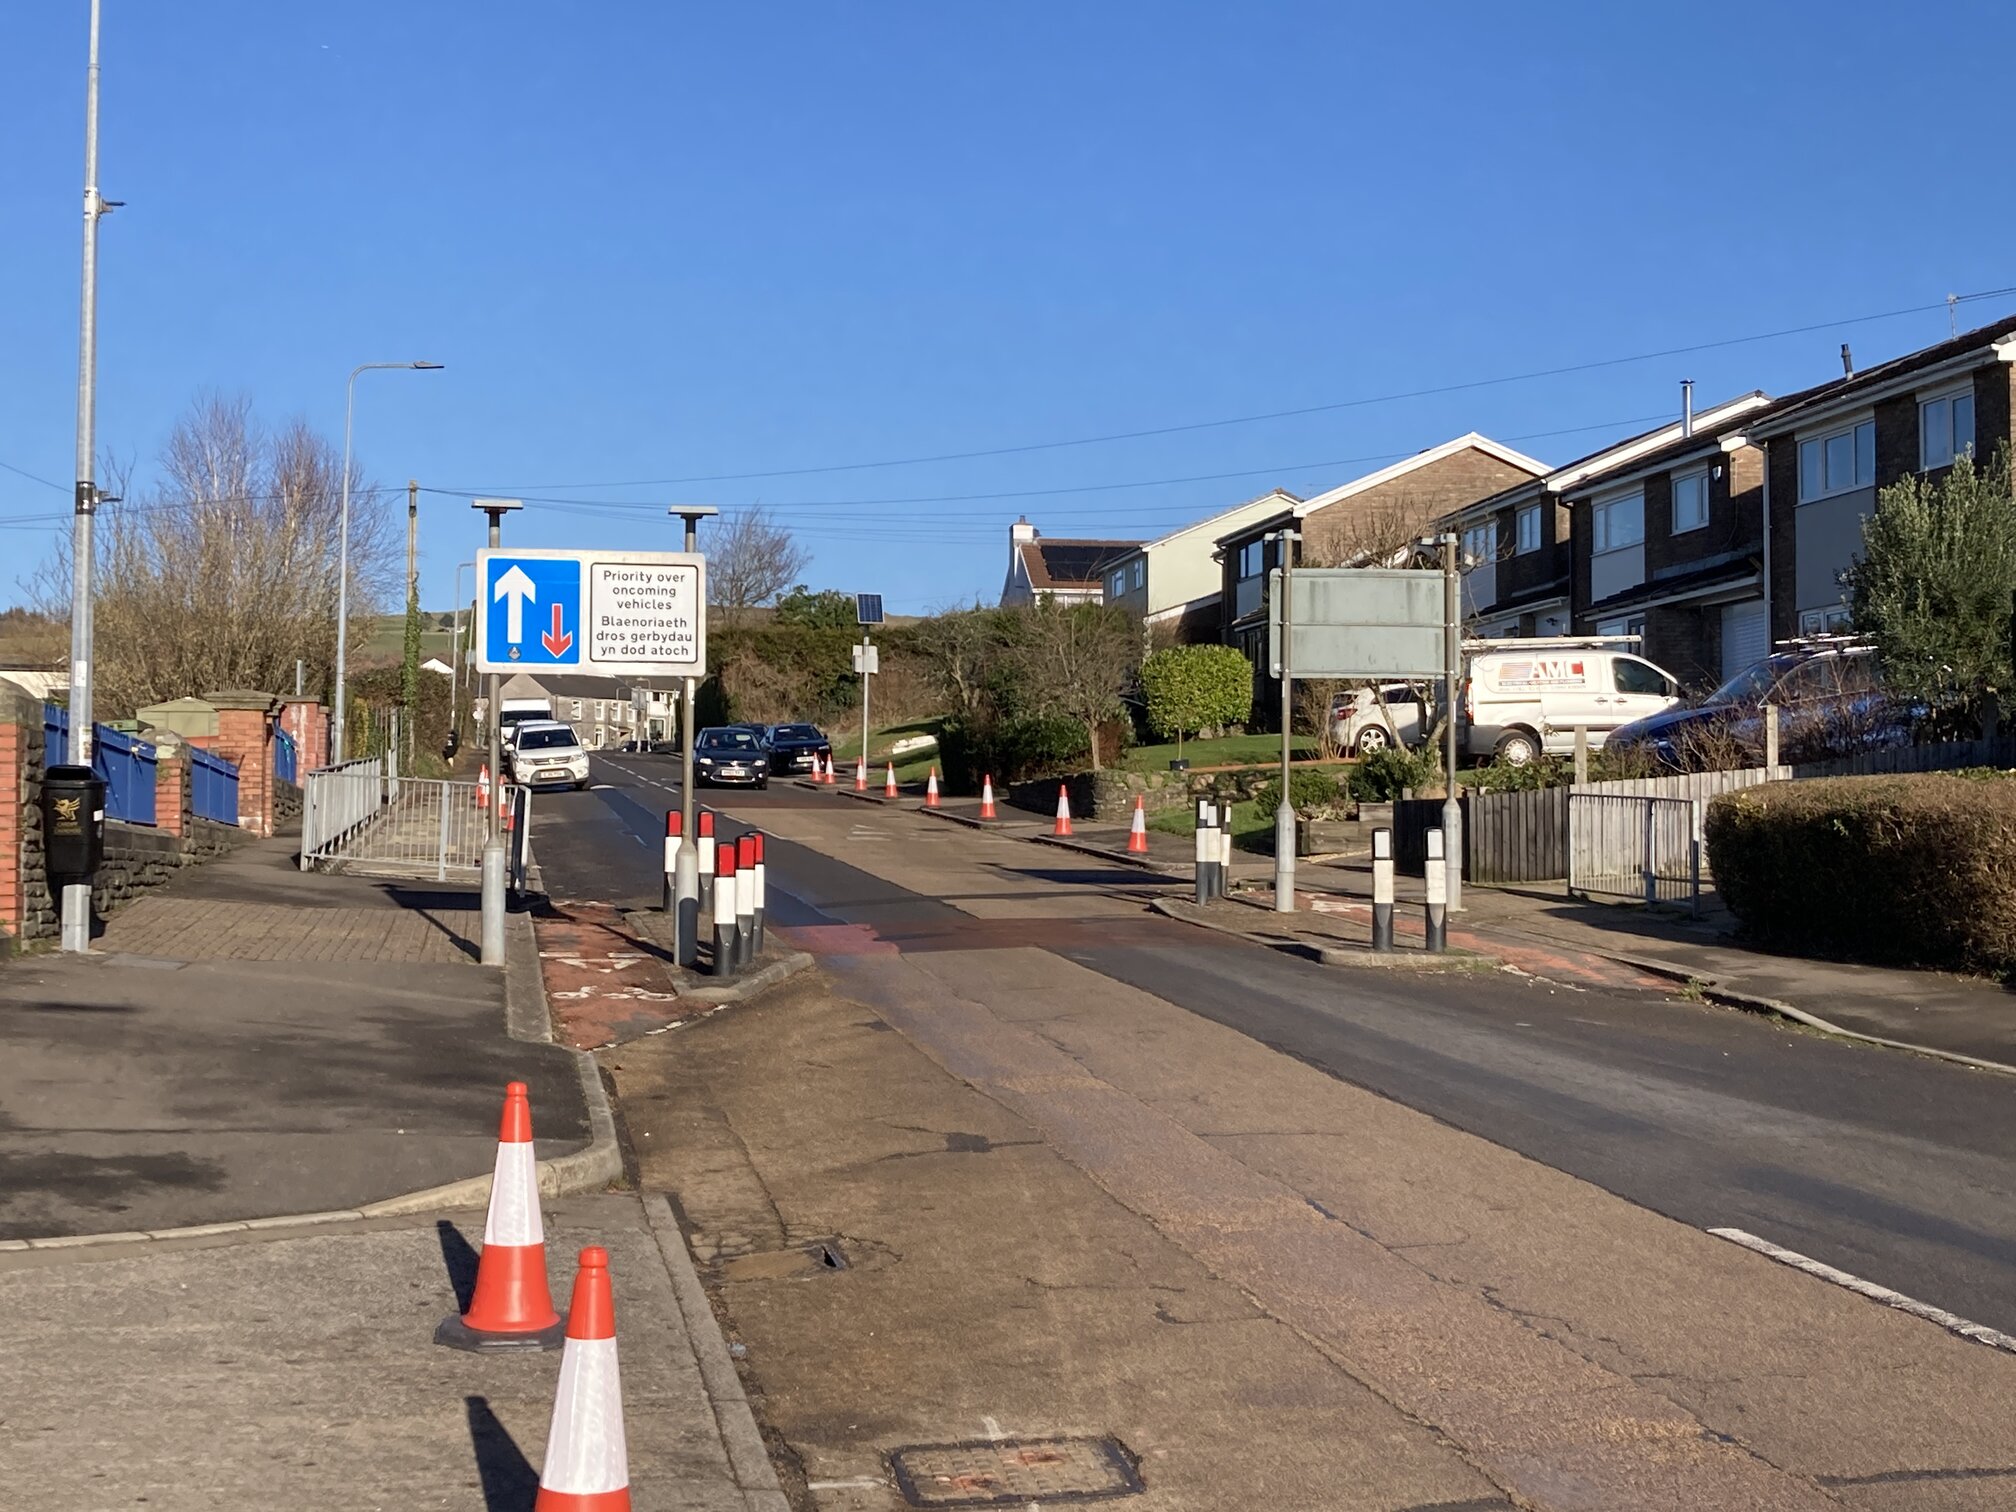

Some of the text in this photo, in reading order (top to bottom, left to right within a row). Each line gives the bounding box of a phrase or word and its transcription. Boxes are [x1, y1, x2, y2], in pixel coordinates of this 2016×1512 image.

[603, 570, 686, 584] Priority over
[612, 585, 677, 598] oncoming
[617, 599, 672, 610] vehicles
[601, 616, 688, 628] Blaenoriaeth
[596, 631, 693, 644] dros gerbydau
[600, 644, 689, 657] yn dod atoch
